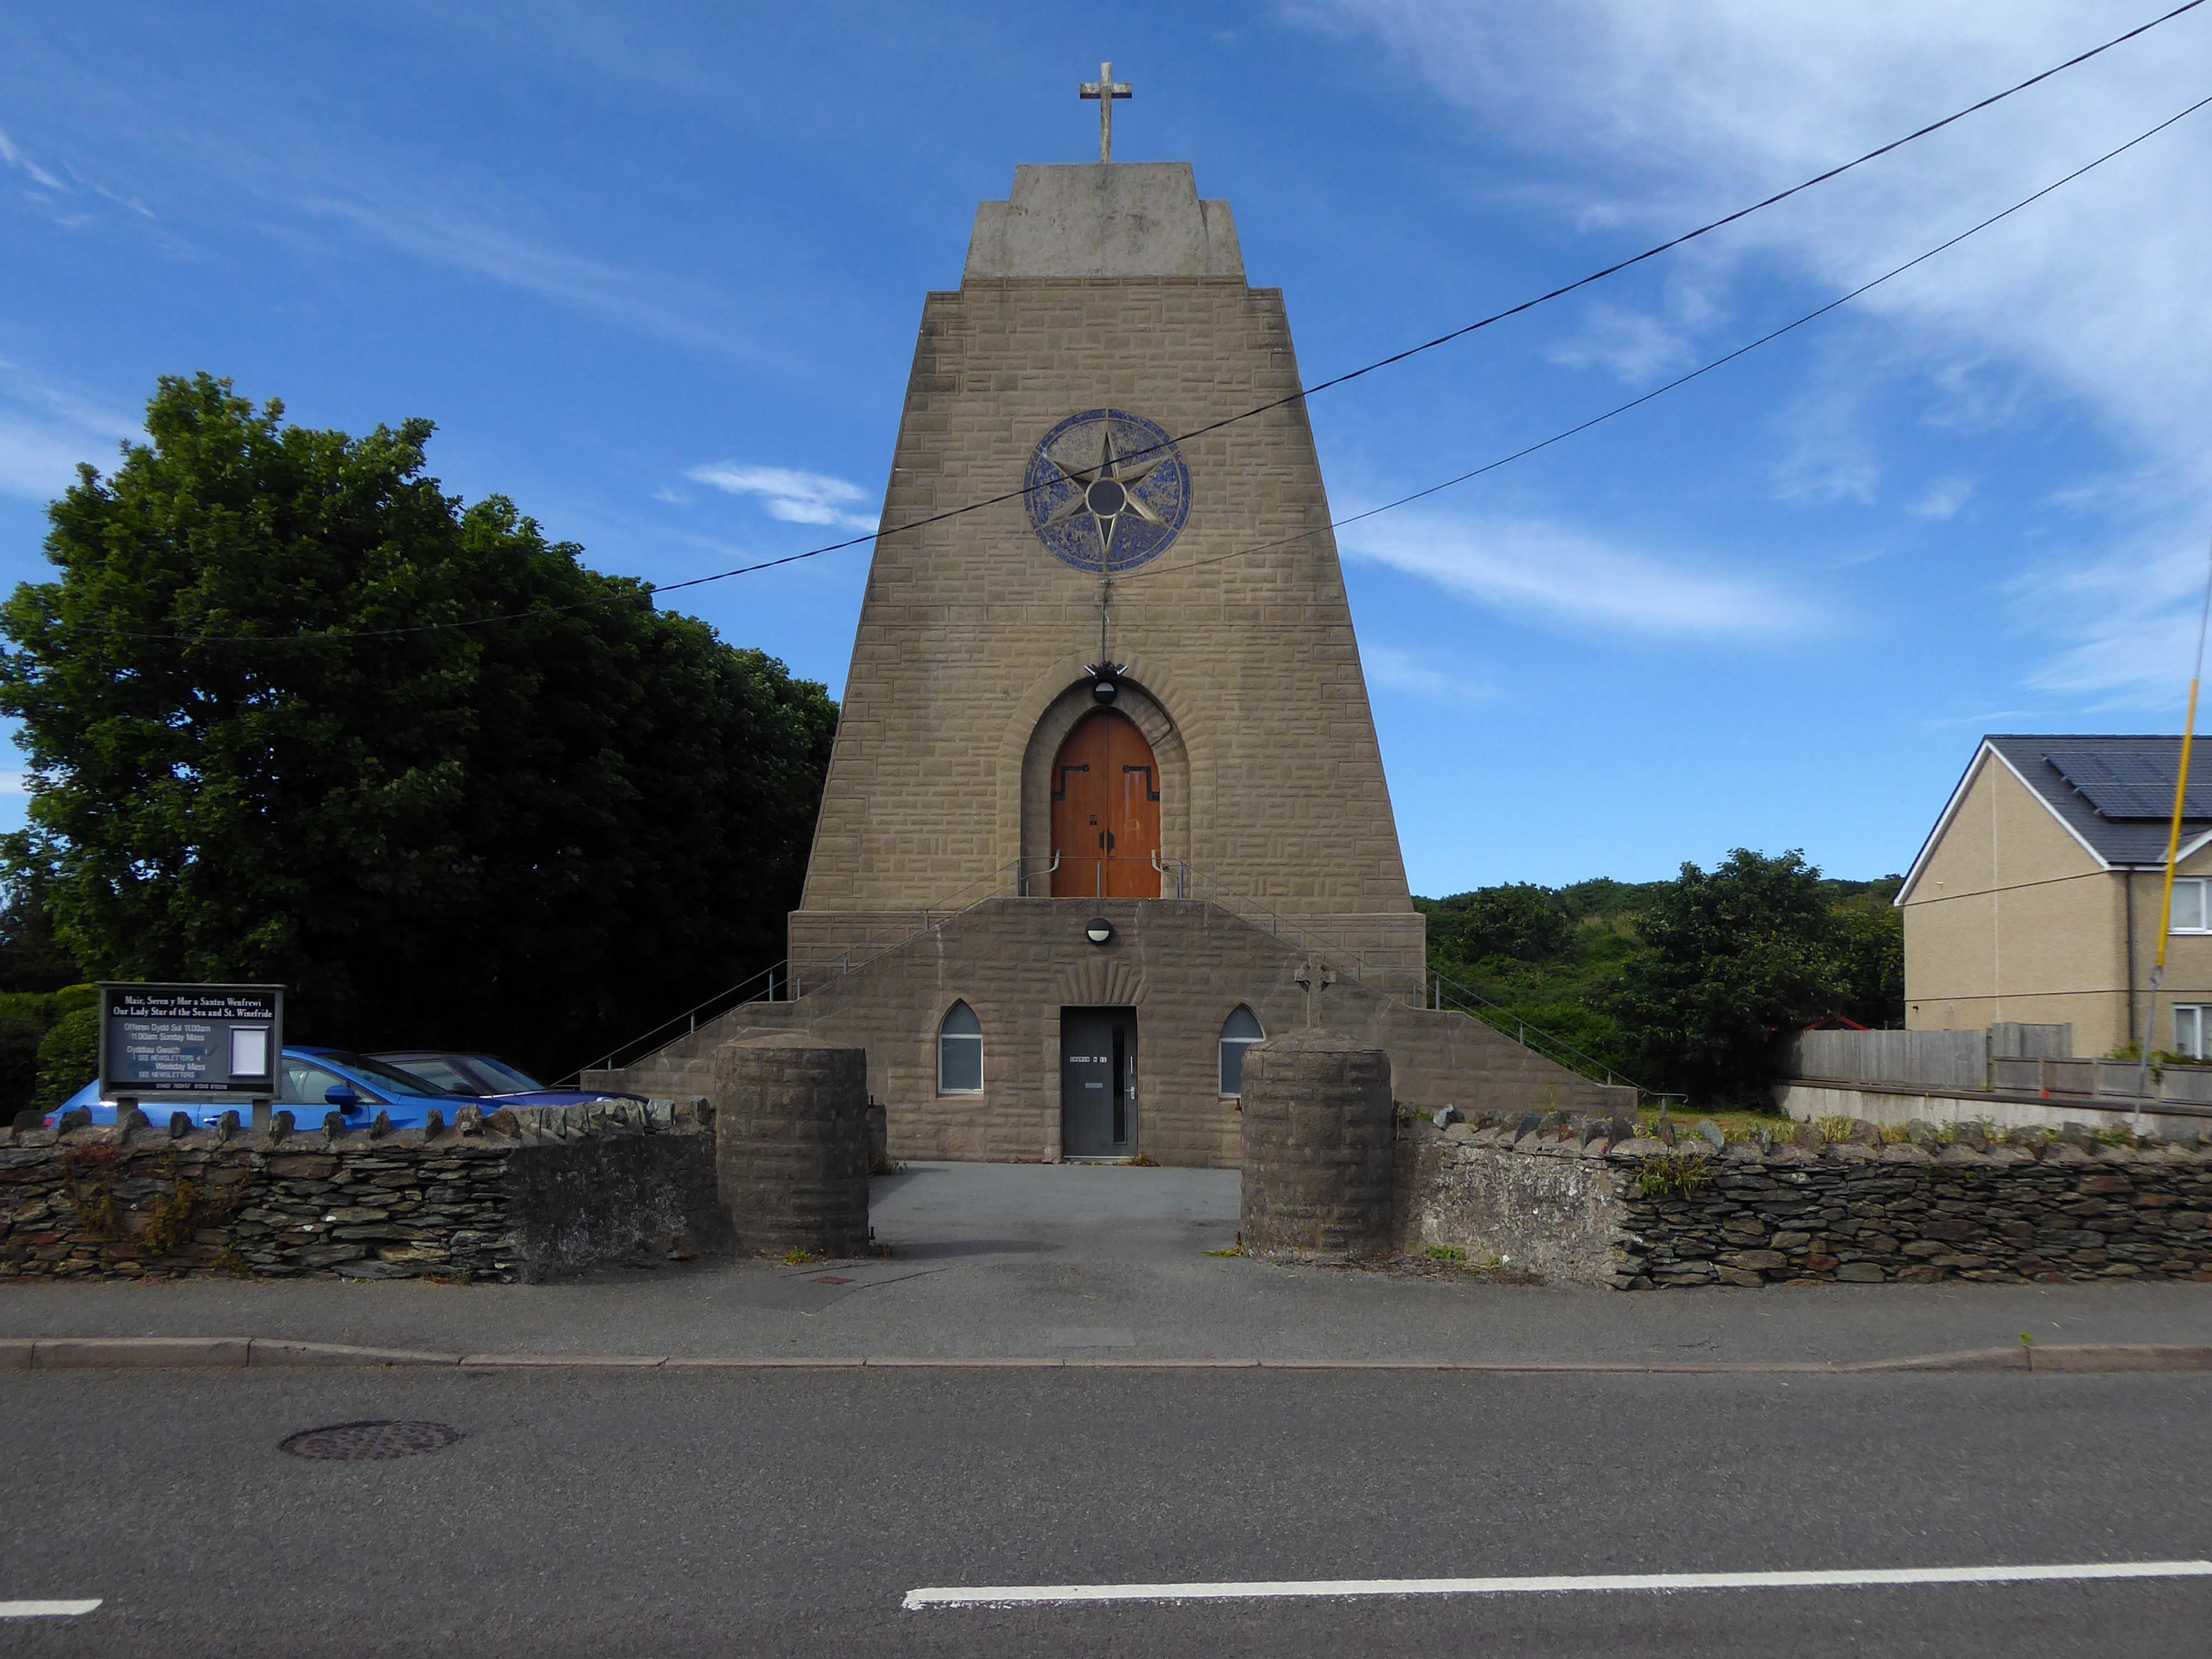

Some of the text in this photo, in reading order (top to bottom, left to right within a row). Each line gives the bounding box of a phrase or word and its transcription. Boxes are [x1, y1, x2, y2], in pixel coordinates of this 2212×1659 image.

[147, 997, 168, 1005] Seren
[200, 997, 225, 1006] Santes
[227, 998, 261, 1007] Wenfrewi
[113, 1006, 272, 1018] Our Lady Star of the Sea and St. Winefride
[152, 1023, 169, 1032] Dydd
[159, 1033, 184, 1042] Sunday
[155, 1062, 185, 1071] Weekday
